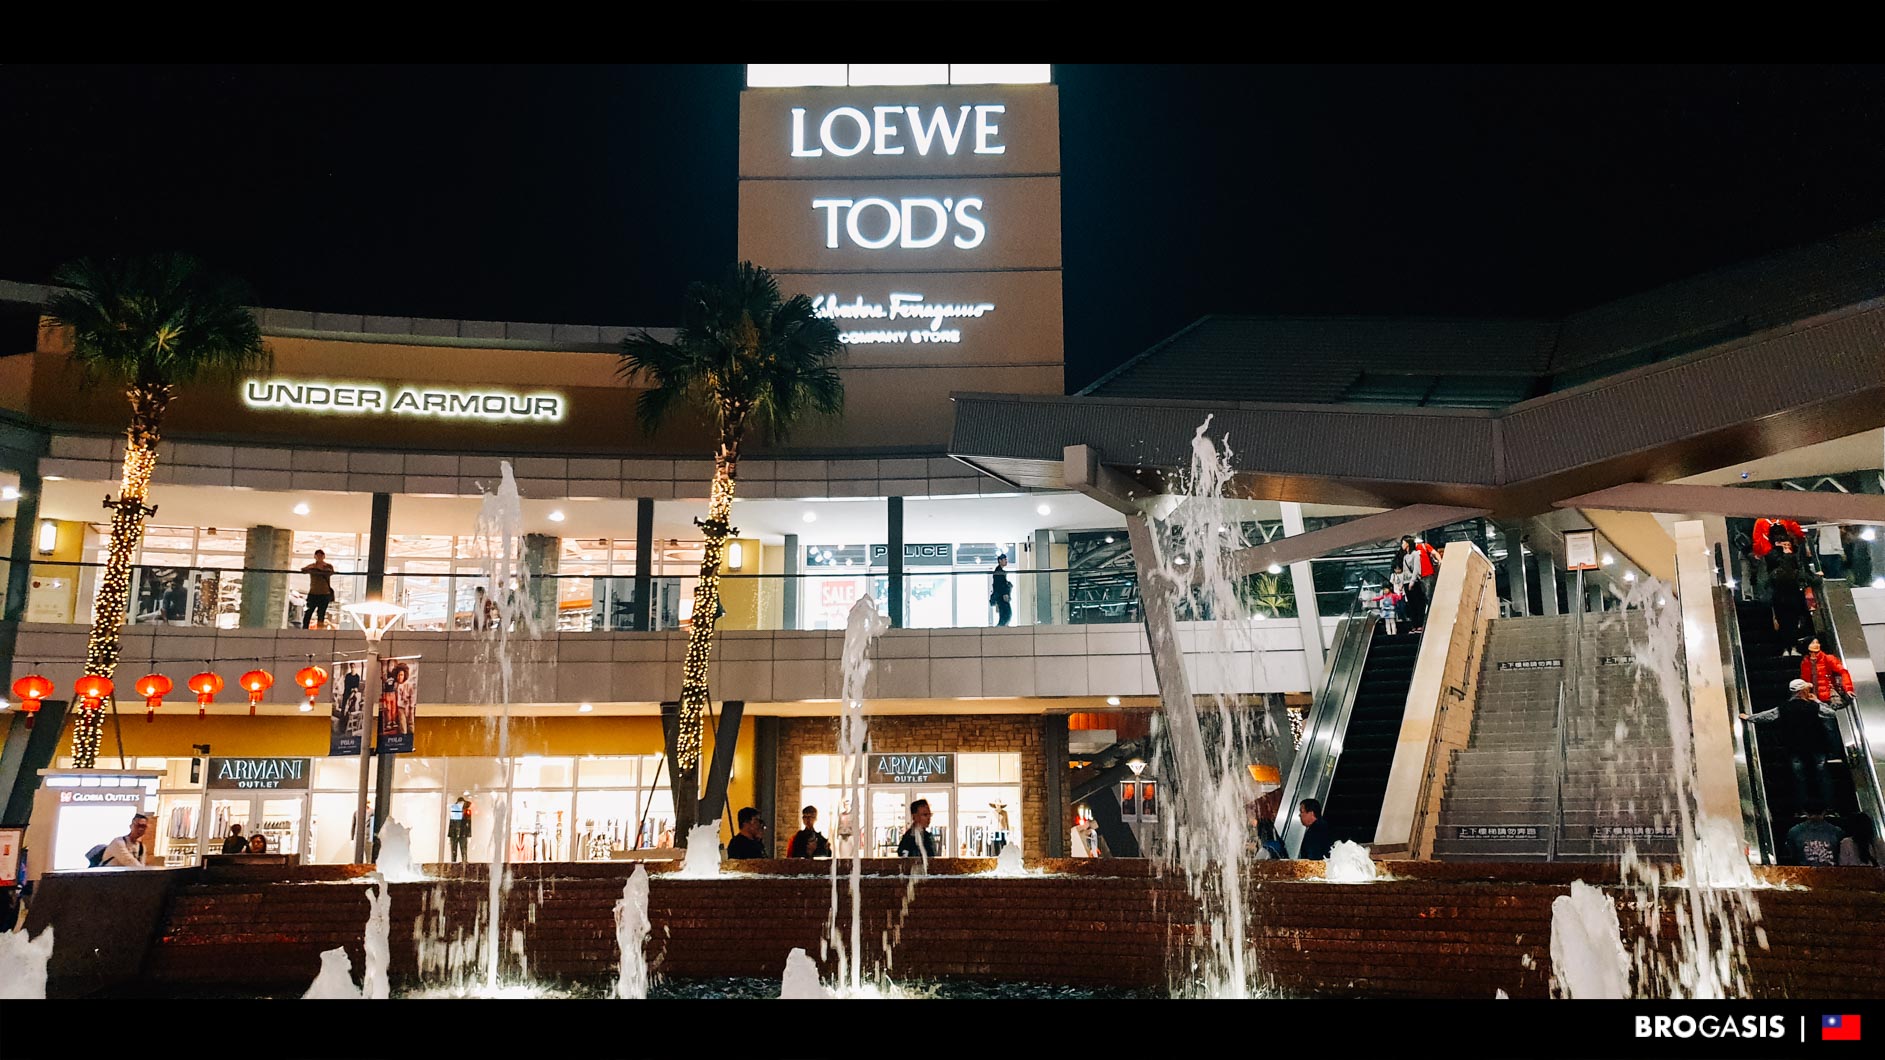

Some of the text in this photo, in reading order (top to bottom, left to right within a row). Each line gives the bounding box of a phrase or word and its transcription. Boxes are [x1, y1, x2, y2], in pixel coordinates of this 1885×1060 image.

[791, 105, 1006, 158] LOEWE
[812, 197, 986, 249] TOD'S
[837, 329, 961, 345] COMPANY STORE
[247, 383, 559, 417] UNDER ARMOUR
[874, 545, 948, 558] PLICE
[822, 586, 855, 603] SALE
[218, 759, 303, 780] ARMANI
[876, 755, 947, 775] ARMANI
[238, 780, 280, 788] OUTLET
